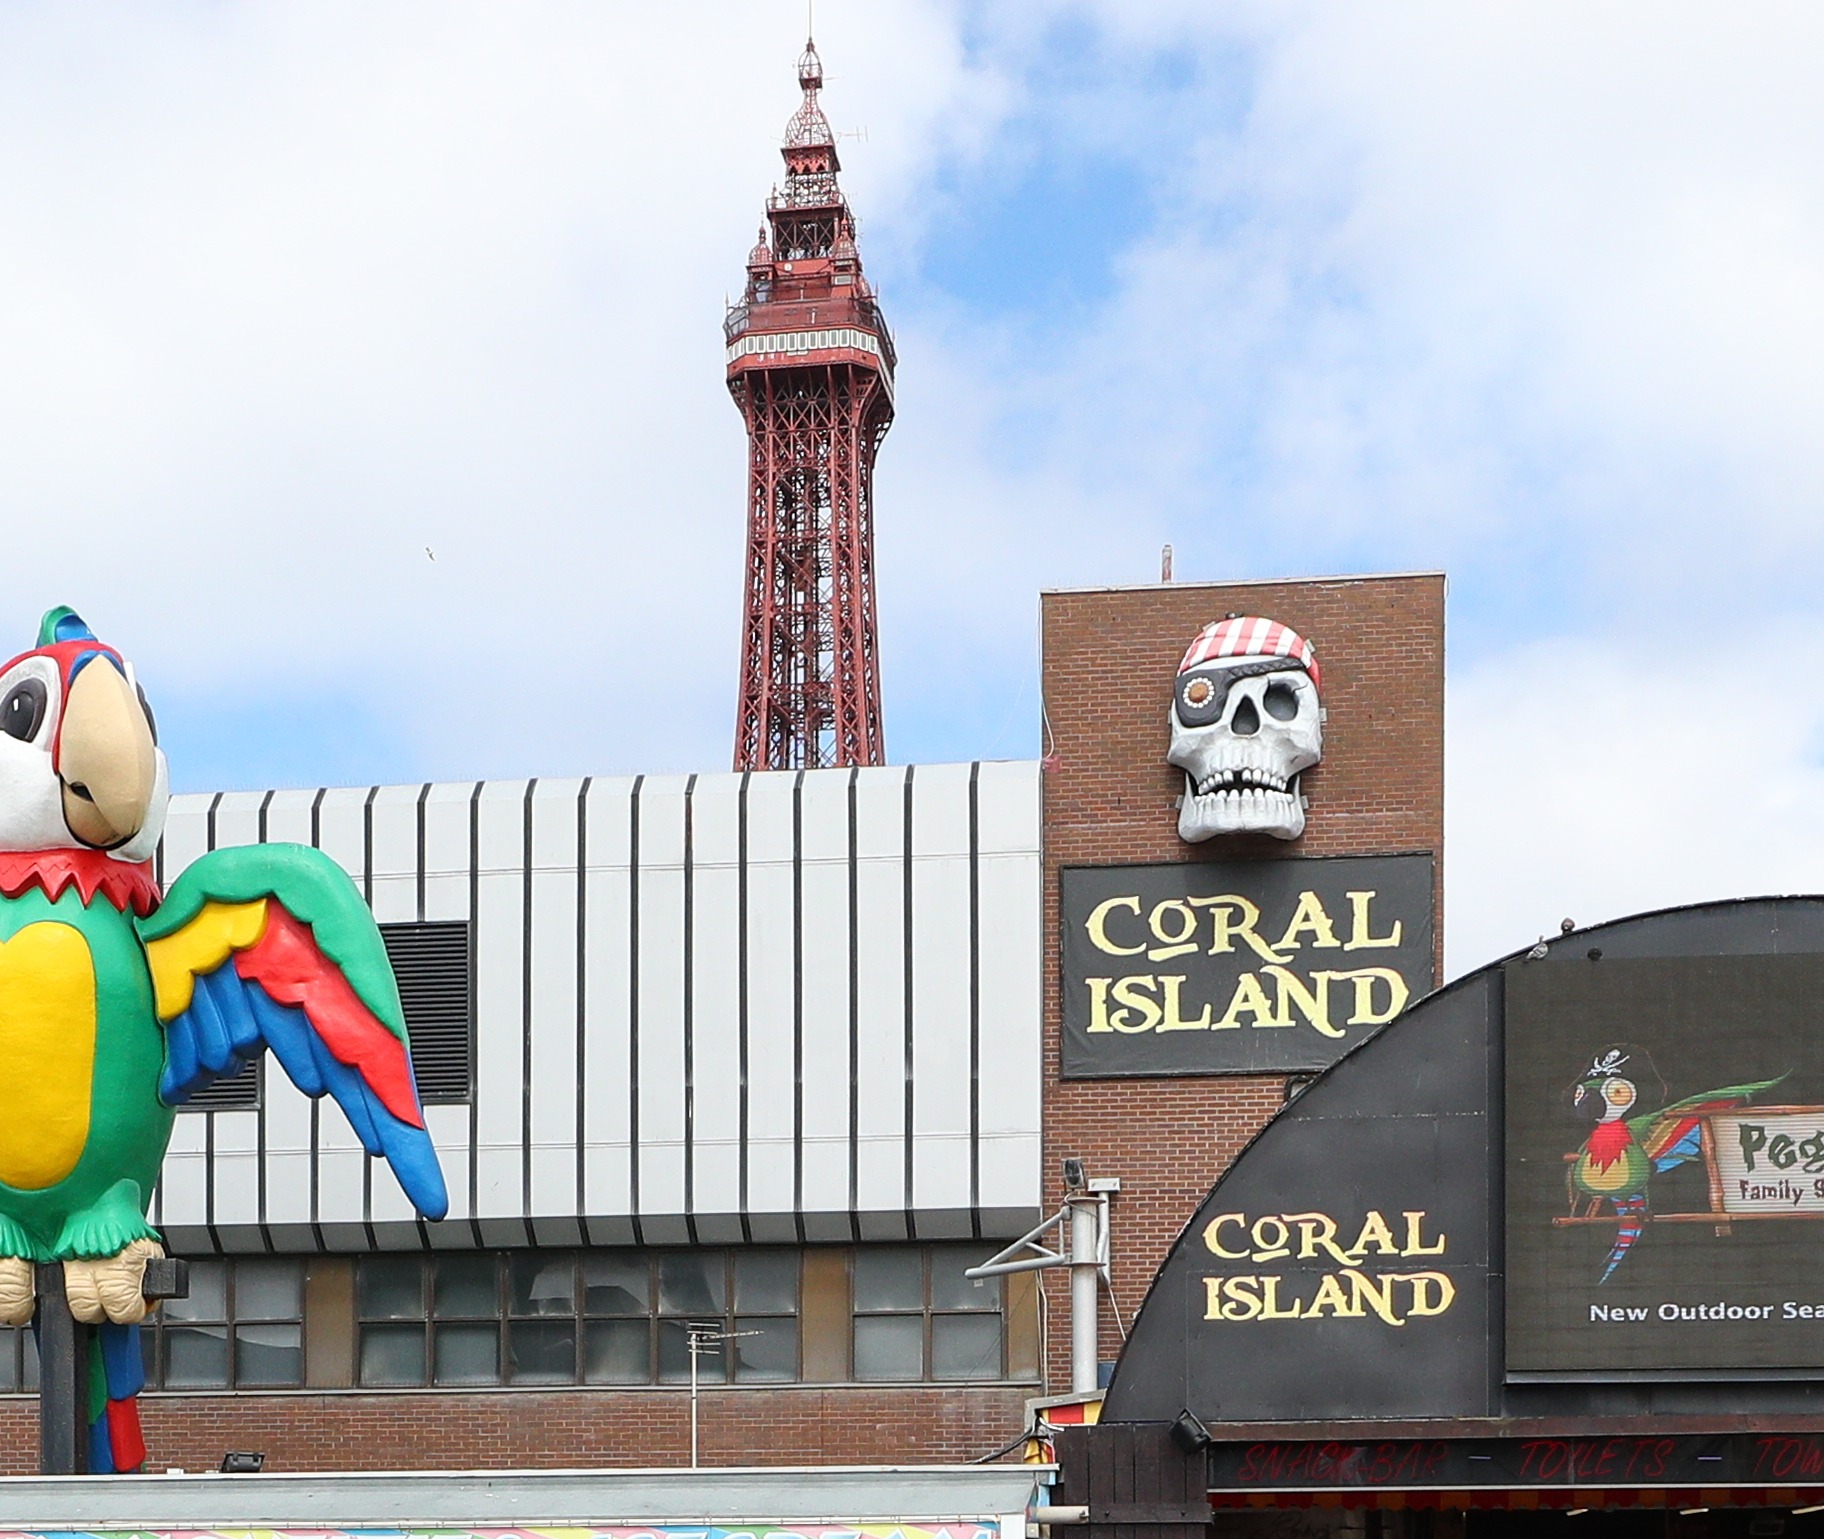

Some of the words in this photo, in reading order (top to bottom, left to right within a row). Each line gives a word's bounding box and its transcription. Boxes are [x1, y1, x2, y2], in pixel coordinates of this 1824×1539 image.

[1085, 889, 1403, 963] CORAL
[1085, 964, 1411, 1038] ISLAND
[1739, 1179, 1803, 1206] Family
[1202, 1210, 1446, 1266] CORAL
[1202, 1268, 1456, 1327] ISLAND
[1589, 1303, 1648, 1322] New
[1657, 1302, 1774, 1321] Outdoor
[1519, 1438, 1676, 1479] TOILETS
